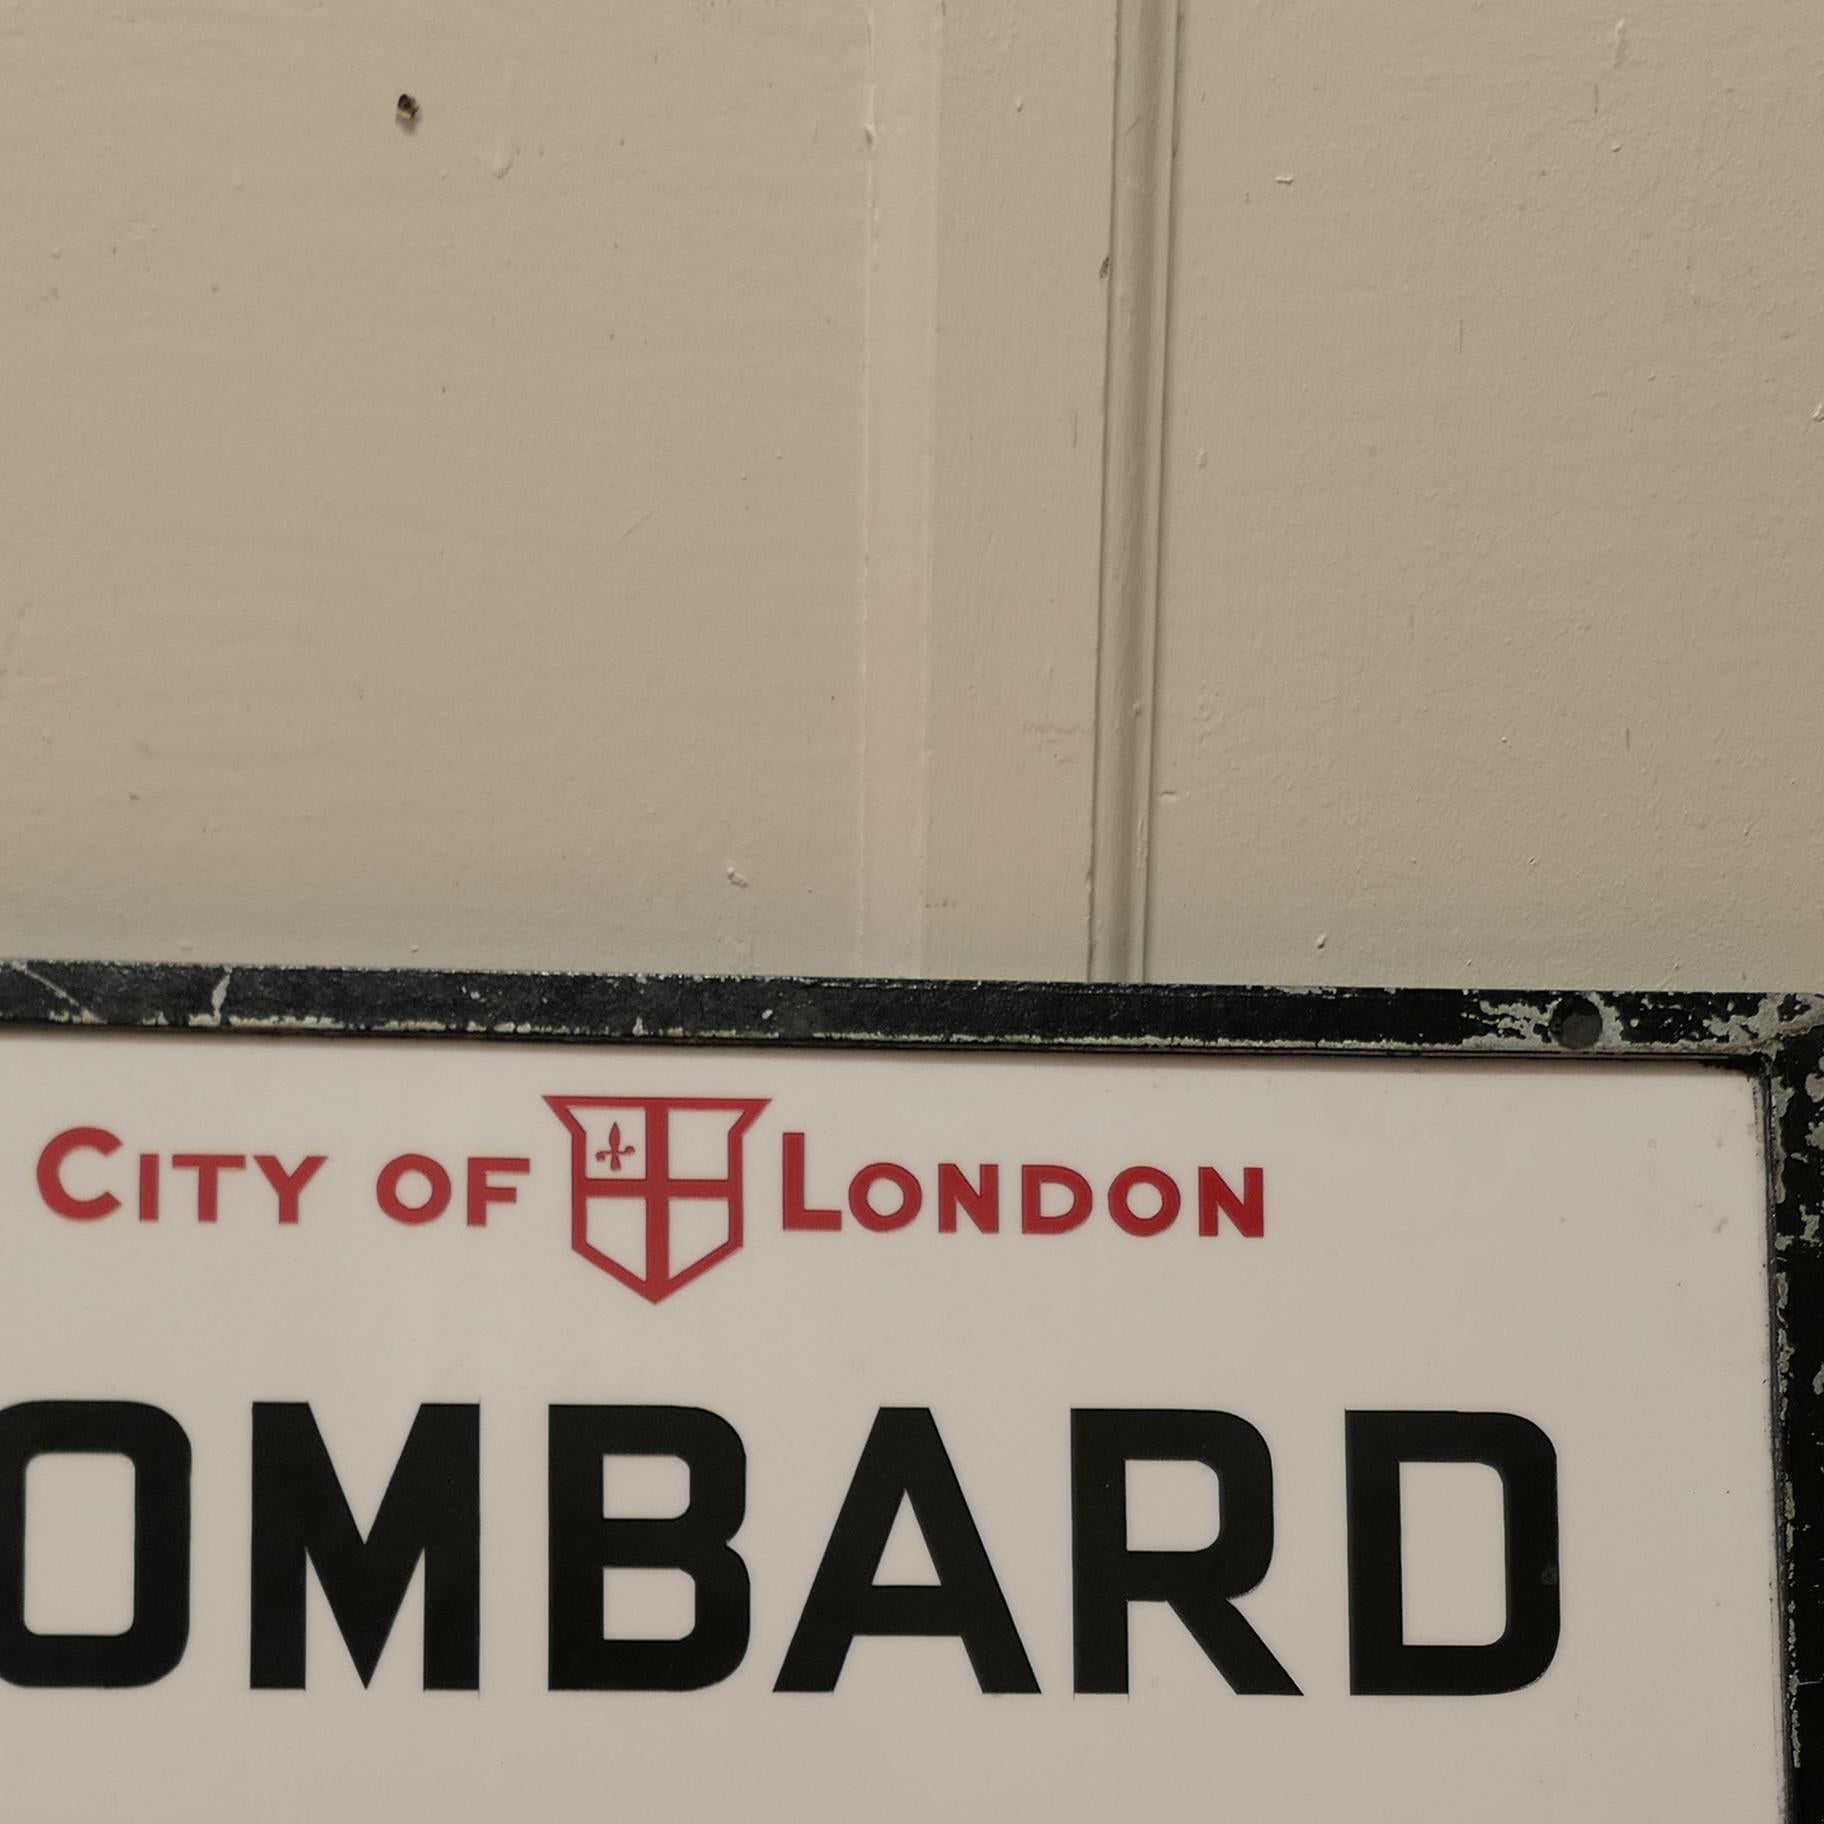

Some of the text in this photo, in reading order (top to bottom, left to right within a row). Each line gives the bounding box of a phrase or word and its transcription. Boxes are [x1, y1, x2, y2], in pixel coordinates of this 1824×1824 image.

[34, 1123, 1267, 1240] CITY OF LONDON
